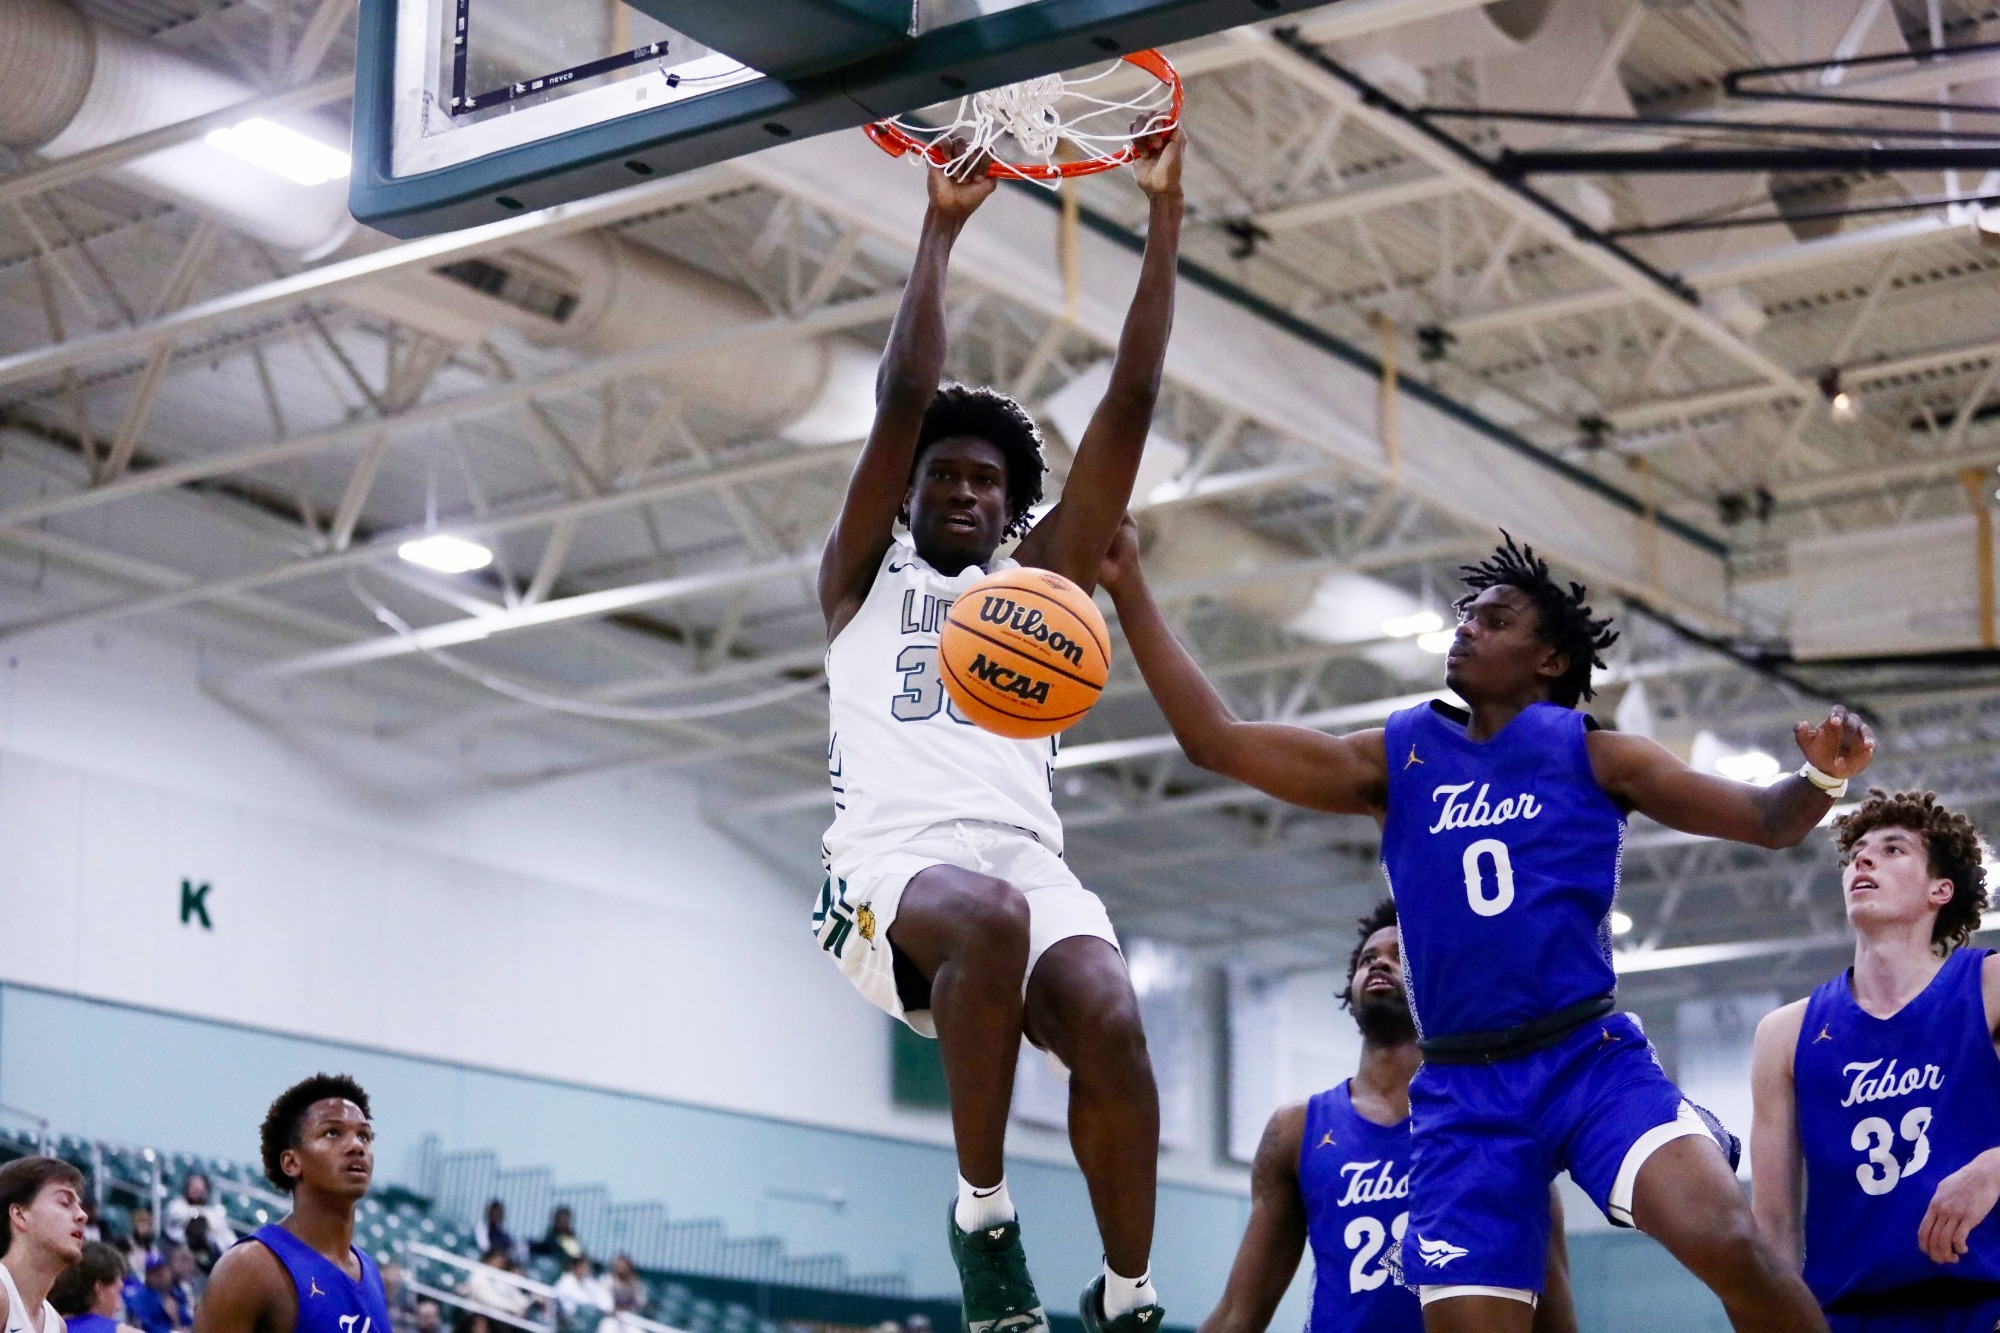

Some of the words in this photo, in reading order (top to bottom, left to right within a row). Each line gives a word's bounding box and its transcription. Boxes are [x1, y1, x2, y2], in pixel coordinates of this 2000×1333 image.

[979, 596, 1084, 667] Wilson
[891, 645, 976, 726] 3
[967, 653, 1051, 705] NCAA
[1429, 780, 1542, 834] Tabor
[181, 879, 211, 928] K
[1462, 838, 1515, 917] 0
[1841, 1057, 1945, 1107] Tabor
